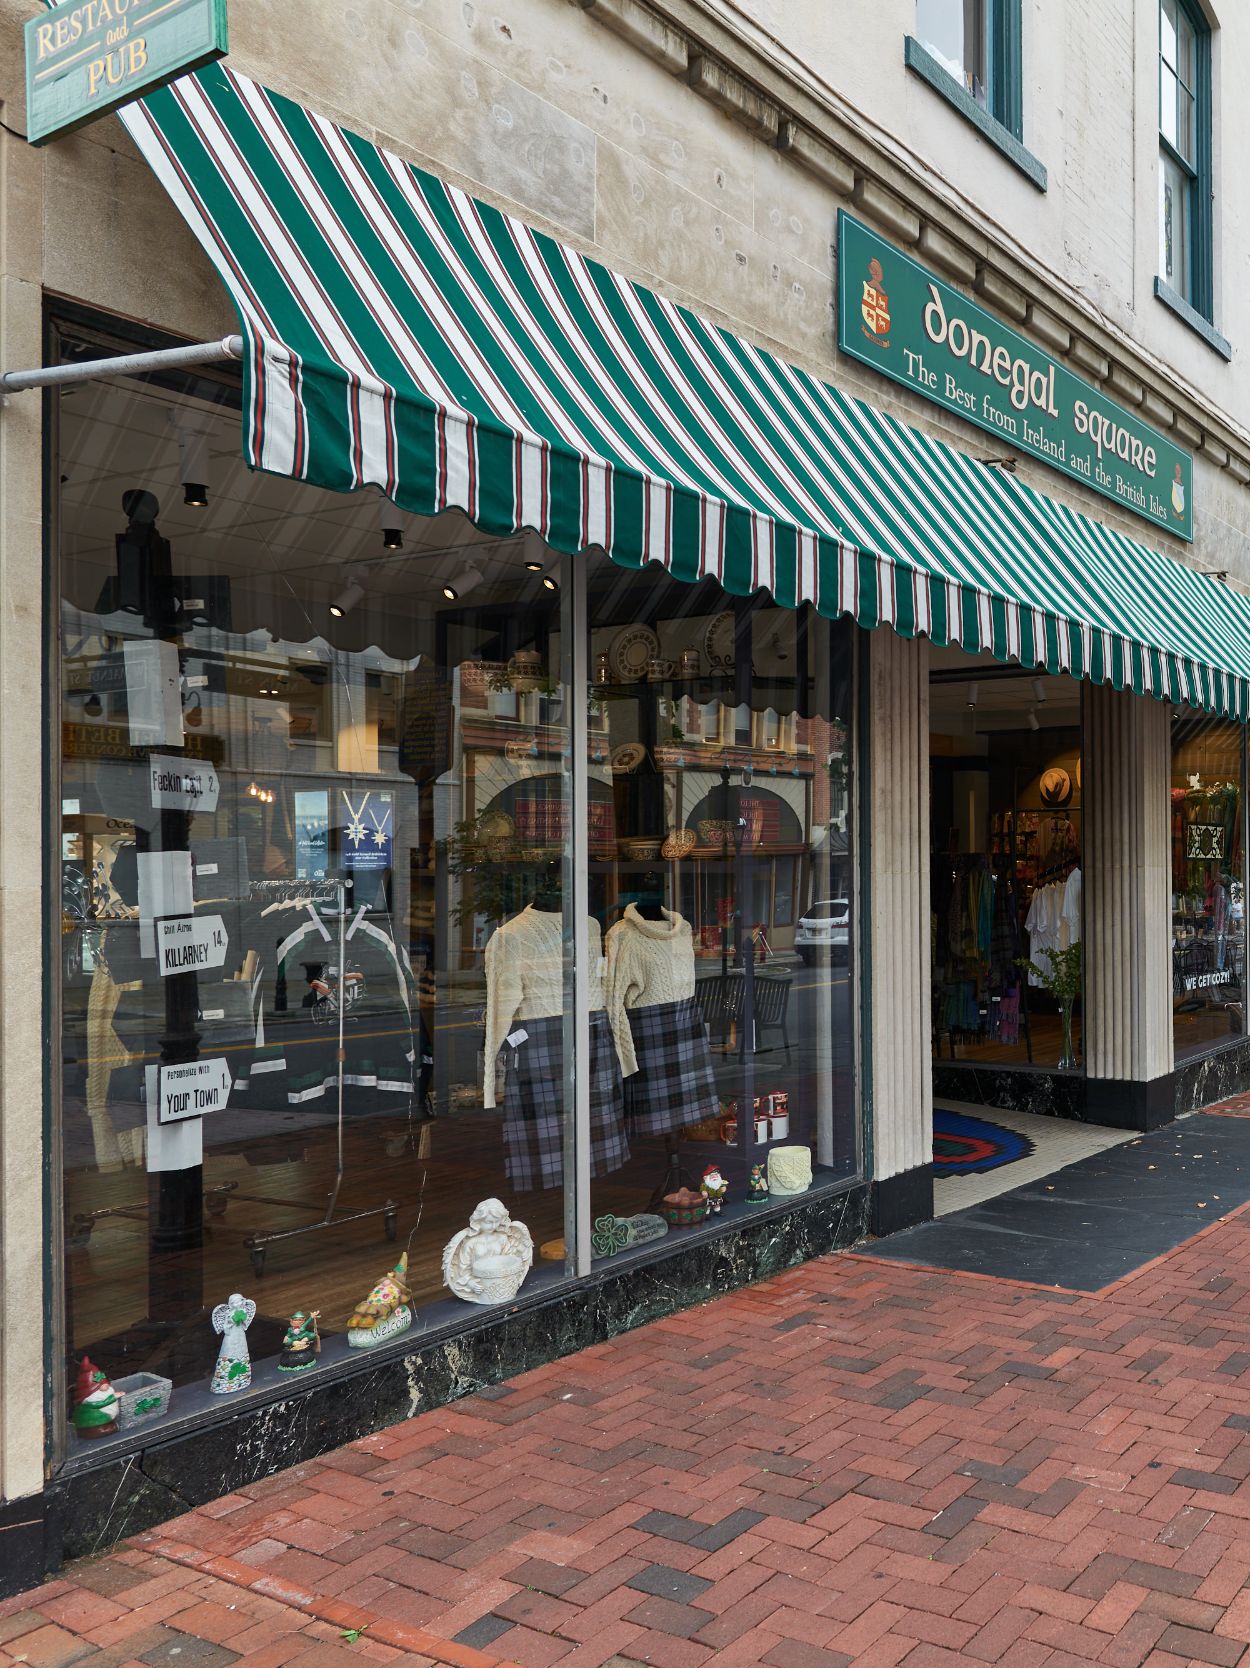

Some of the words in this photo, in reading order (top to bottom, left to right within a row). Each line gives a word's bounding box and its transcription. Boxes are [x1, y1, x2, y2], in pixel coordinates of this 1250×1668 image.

[36, 0, 138, 60] RESTAU
[106, 16, 129, 46] and
[88, 37, 148, 96] PUB
[903, 348, 938, 389] The
[944, 373, 977, 412] Best
[982, 395, 1018, 436] from
[1022, 418, 1066, 462] Ireland
[1070, 454, 1091, 477] and
[1095, 462, 1112, 488] the
[1115, 474, 1146, 509] British
[1149, 494, 1168, 520] Isles
[152, 770, 182, 793] Feckin
[212, 929, 223, 948] 14
[165, 943, 209, 969] KILLARNEY
[1185, 977, 1197, 991] WE
[1198, 974, 1211, 988] GET
[1211, 970, 1230, 985] COZY!
[166, 1092, 191, 1114] Your
[193, 1087, 219, 1109] Town
